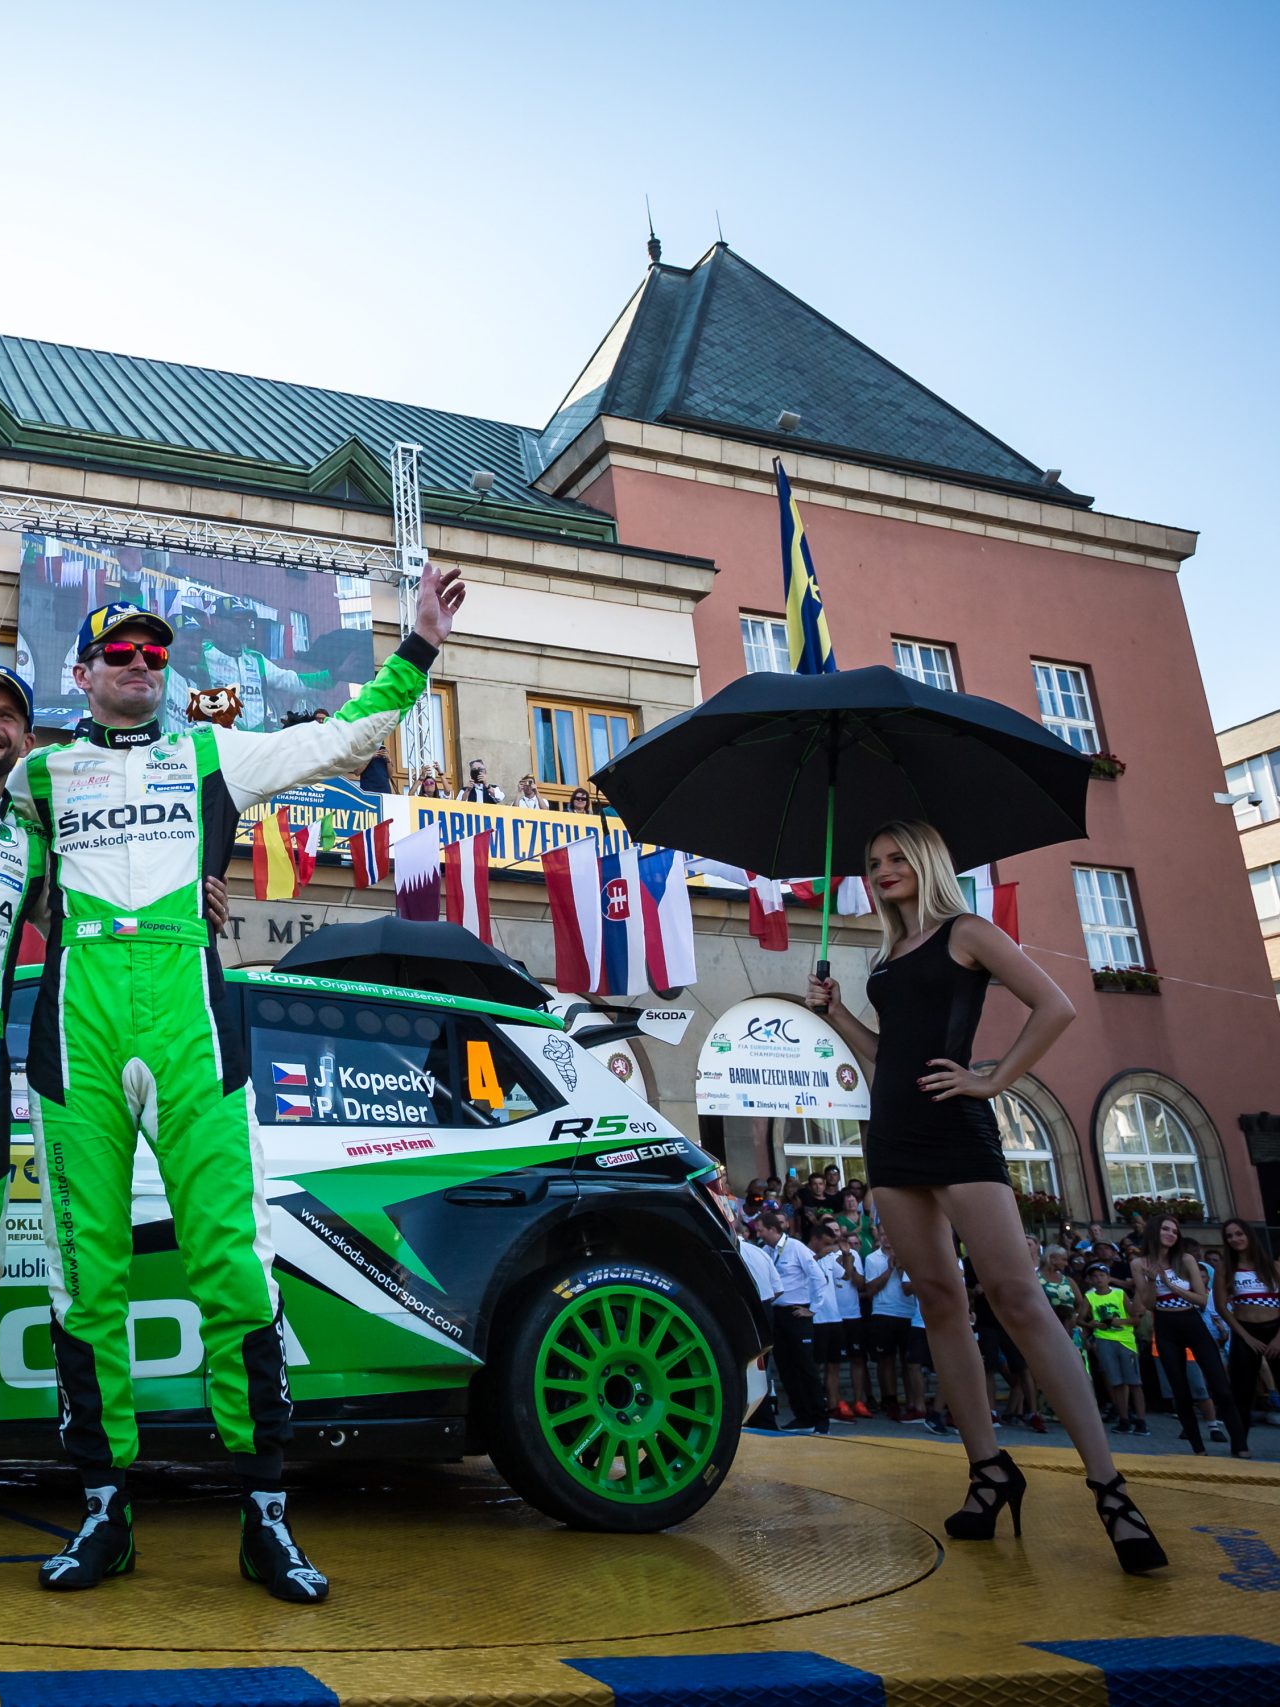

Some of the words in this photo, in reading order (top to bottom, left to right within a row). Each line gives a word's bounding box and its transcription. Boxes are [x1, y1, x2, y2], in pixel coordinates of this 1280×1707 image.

[115, 733, 151, 743] ŠKODA
[146, 762, 188, 771] ŠKODA
[157, 784, 192, 792] MICHELIN
[276, 795, 325, 803] CHAMPIONSHIP
[58, 803, 193, 838] ŠKODA
[60, 829, 195, 853] www.skoda-auto.com
[76, 923, 102, 936] OMP
[139, 921, 182, 934] Kopecký
[247, 972, 319, 987] ŠKODA
[320, 979, 380, 995] Originální
[382, 986, 457, 1005] příslušenství
[646, 1010, 687, 1020] ŠKODA
[314, 1066, 334, 1087] J.
[338, 1066, 435, 1098] Kopecký
[467, 1041, 505, 1109] 4
[729, 1067, 760, 1085] BARUM
[762, 1069, 788, 1086] CZECH
[789, 1070, 810, 1087] RALLY
[811, 1069, 830, 1088] ZLÍN
[317, 1096, 338, 1119] P.
[343, 1098, 428, 1123] Dresler
[794, 1092, 818, 1107] zlín
[549, 1115, 629, 1141] R5
[629, 1121, 657, 1133] evo
[606, 1151, 637, 1166] Castrol
[638, 1142, 689, 1161] EDGE
[53, 1142, 80, 1297] www.skoda-auto.com
[301, 1208, 464, 1339] www.skoda-motorsport.com
[587, 1268, 673, 1291] MICHELIN
